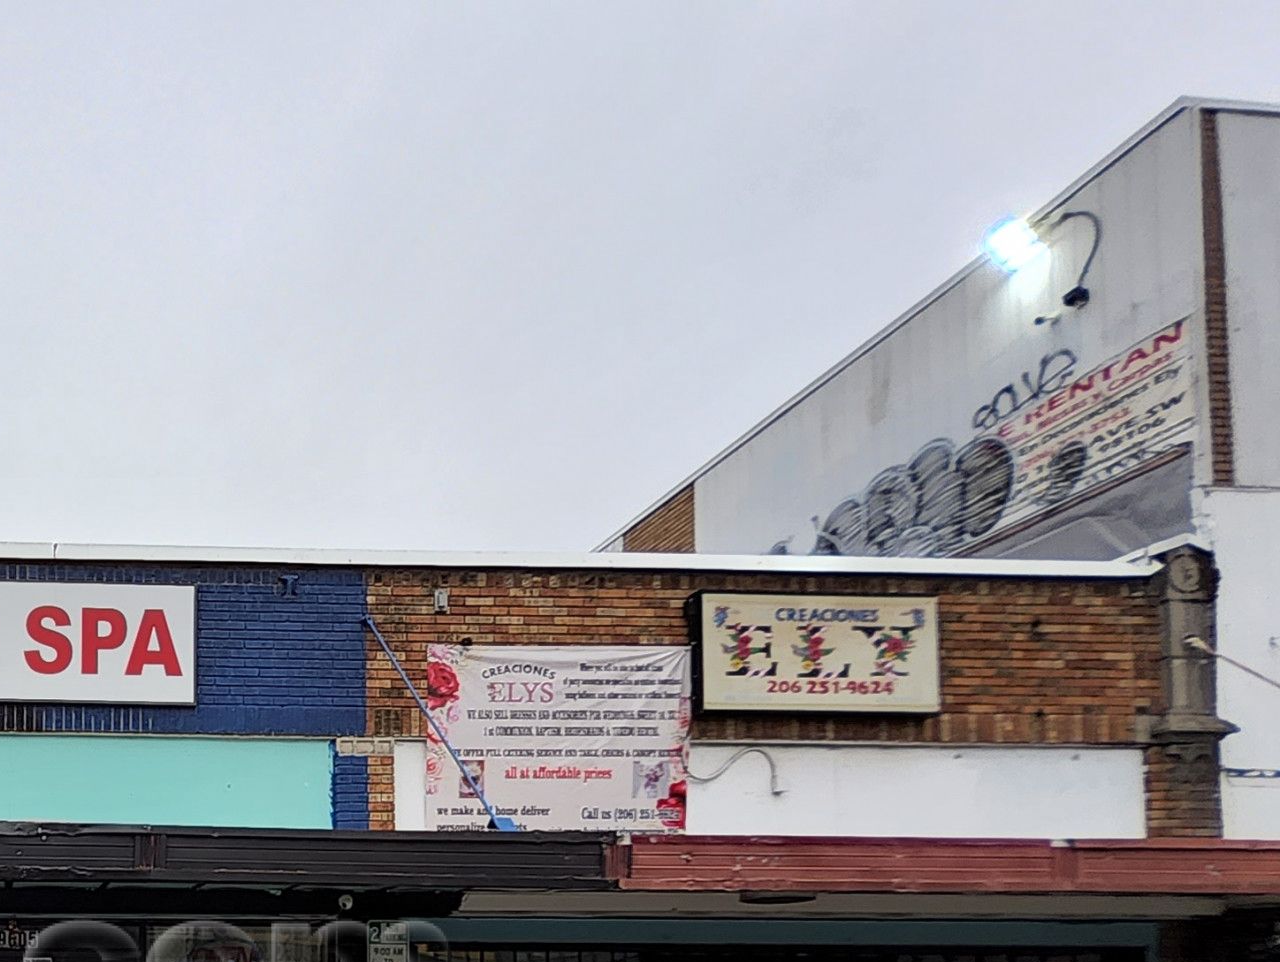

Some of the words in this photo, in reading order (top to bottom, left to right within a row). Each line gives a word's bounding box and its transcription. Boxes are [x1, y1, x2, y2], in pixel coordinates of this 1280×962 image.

[775, 607, 880, 622] CREACIONES
[23, 605, 183, 677] SPA
[482, 664, 556, 679] CREACIONES
[488, 681, 554, 703] ELYS
[767, 681, 802, 694] 206
[505, 766, 517, 779] all
[520, 768, 530, 779] at
[532, 766, 581, 779] affordable
[583, 767, 613, 783] prices
[451, 805, 474, 816] make
[520, 805, 551, 816] deliver
[581, 807, 599, 820] Call
[370, 926, 380, 942] 2
